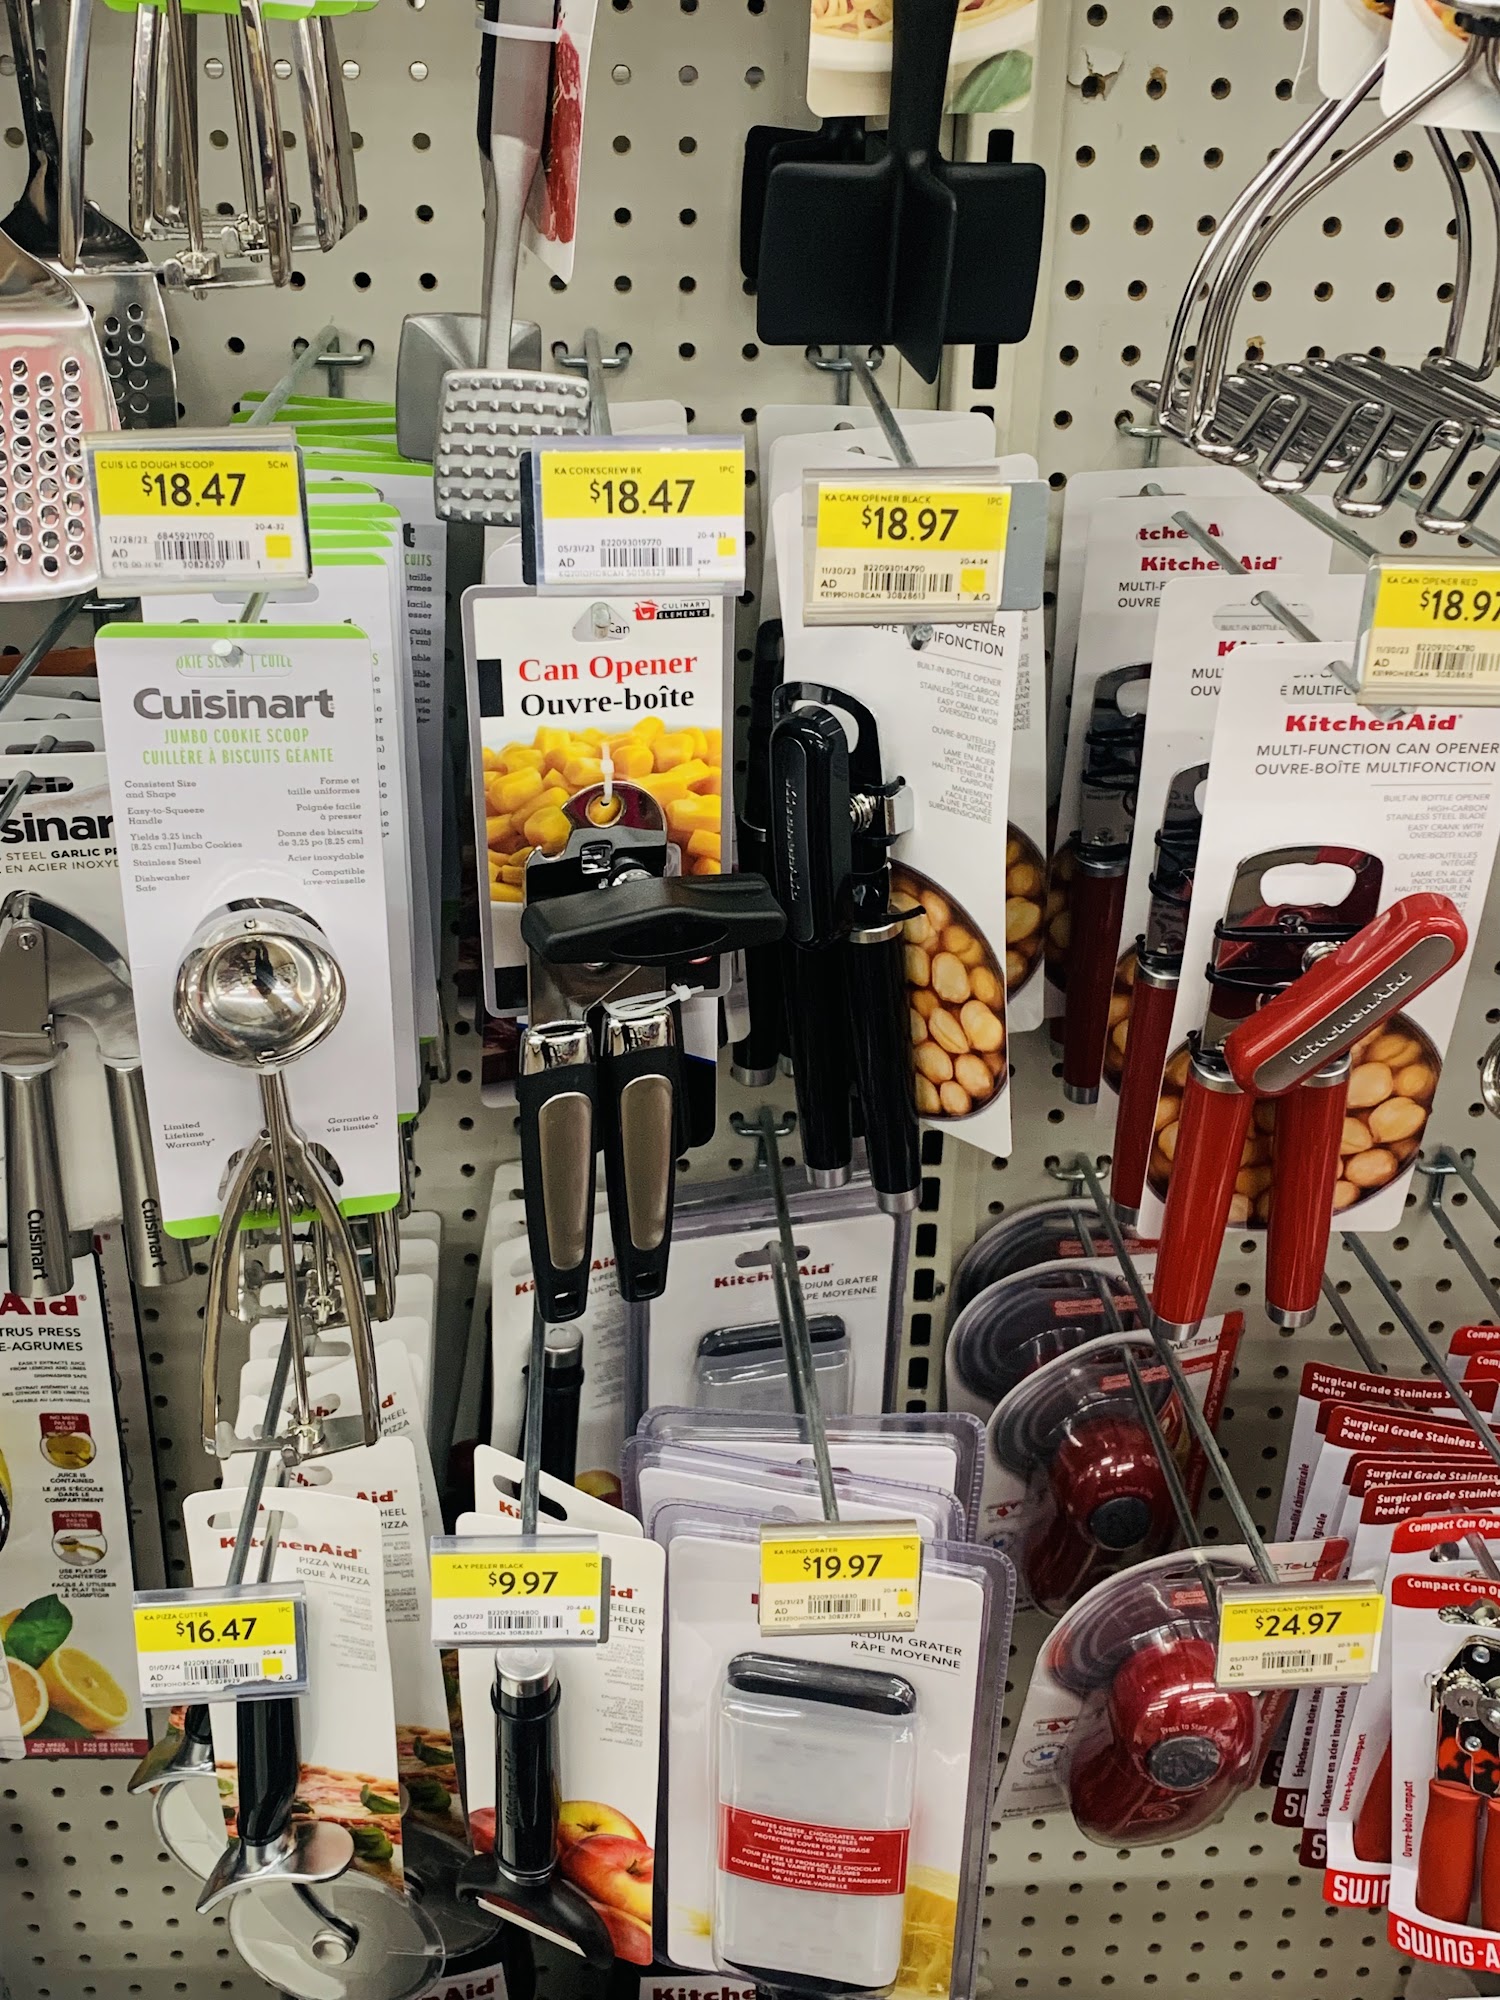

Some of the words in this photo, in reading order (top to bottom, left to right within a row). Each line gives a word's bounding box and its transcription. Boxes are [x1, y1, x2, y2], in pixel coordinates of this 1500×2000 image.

[100, 461, 124, 469] CUIS
[126, 461, 138, 469] LG
[140, 461, 177, 469] DOUGH
[180, 460, 214, 469] SCOOP
[554, 467, 567, 475] KA
[569, 467, 628, 475] CORKSCREW
[141, 472, 246, 507] $18.47
[590, 478, 695, 514] $18.47
[825, 494, 837, 502] KA
[839, 494, 860, 503] CAN
[862, 495, 900, 503] OPENER
[902, 495, 931, 504] BLACK
[861, 505, 959, 542] $18.97
[111, 549, 128, 558] AD
[558, 558, 575, 567] AD
[1140, 556, 1279, 571] KitcheAid
[821, 580, 837, 588] AD
[1422, 577, 1458, 585] OPENER
[1460, 578, 1478, 586] RED
[661, 601, 707, 610] CULINARY
[658, 610, 709, 619] ELEMENTS
[1373, 658, 1390, 666] AD
[518, 658, 579, 682] Can
[589, 655, 697, 684] Opener
[946, 667, 972, 680] BOTTLE
[973, 673, 1001, 686] OPENER
[133, 687, 335, 719] Cuisinart
[520, 684, 695, 717] Ouvre-boîte
[1285, 713, 1457, 732] KitchenAid
[164, 728, 208, 744] JUMBO
[213, 727, 262, 743] COOKIE
[267, 727, 309, 743] SCOOP
[1256, 743, 1391, 756] MULTI-FUNCTION
[1396, 742, 1431, 754] CAN
[1435, 741, 1500, 754] OPENER
[142, 748, 204, 766] CUILLÈRE
[209, 746, 217, 765] À
[222, 747, 280, 765] BISCUITS
[286, 746, 334, 764] GÉANTE
[1254, 758, 1360, 775] OUVRE-BOÎTE
[1366, 761, 1496, 774] MULTIFONCTION
[124, 779, 174, 789] Consistent
[177, 778, 197, 788] Size
[320, 776, 347, 786] Forme
[353, 776, 360, 785] et
[126, 790, 143, 799] and
[146, 790, 176, 800] Shape
[287, 787, 312, 796] taille
[314, 786, 361, 796] uniformes
[1421, 793, 1454, 803] BOTTLE
[1456, 793, 1491, 802] OPENER
[127, 806, 205, 816] Easy-to-Squeeze
[296, 802, 334, 813] Poignée
[335, 802, 361, 811] facile
[128, 817, 163, 825] Handle
[328, 813, 362, 823] presser
[130, 832, 159, 842] Yields
[161, 832, 180, 841] 3.25
[182, 831, 203, 840] inch
[277, 829, 302, 838] Donne
[305, 828, 322, 838] des
[324, 827, 363, 837] biscuits
[173, 841, 203, 852] Jumbo
[205, 841, 243, 850] Cookies
[6, 851, 47, 862] STEEL
[51, 848, 100, 860] GARLIC
[287, 853, 312, 863] Acier
[313, 852, 364, 864] inoxydable
[5, 865, 23, 875] EN
[28, 862, 67, 873] ACIER
[133, 857, 177, 868] Stainless
[179, 857, 202, 866] Steel
[134, 873, 191, 883] Dishwasher
[312, 867, 365, 879] Compatible
[303, 877, 366, 887] lave-vaisselle
[135, 884, 157, 893] Safe
[163, 1121, 201, 1131] Limited
[327, 1115, 371, 1125] Garantie
[164, 1131, 205, 1140] Lifetime
[141, 1197, 168, 1268] Cuisinart
[27, 1209, 49, 1281] Cuisinart
[836, 1275, 878, 1287] GRATER
[822, 1286, 877, 1299] MOYENNE
[38, 1327, 81, 1337] PRESS
[1311, 1382, 1346, 1398] Peeler
[1313, 1372, 1357, 1390] Surgical
[1359, 1383, 1391, 1396] Grade
[1393, 1385, 1442, 1399] Stainless
[1340, 1428, 1377, 1444] Peeler
[1342, 1416, 1389, 1434] Surgical
[1390, 1425, 1423, 1441] Grade
[1425, 1431, 1476, 1449] Stainless
[1374, 1504, 1411, 1516] Peeler
[1408, 1520, 1454, 1534] Compact
[1456, 1518, 1476, 1529] Can
[299, 1555, 330, 1568] PIZZA
[332, 1562, 371, 1575] WHEEL
[803, 1554, 883, 1579] $19.97
[296, 1566, 326, 1579] ROUE
[340, 1574, 370, 1587] PIZZA
[488, 1571, 559, 1595] $9.97
[1407, 1578, 1461, 1592] Compact
[1463, 1583, 1486, 1595] Can
[144, 1614, 155, 1622] KA
[156, 1613, 177, 1621] PIZZA
[179, 1611, 208, 1620] CUTTER
[618, 1625, 634, 1633] EN
[1255, 1611, 1343, 1637] $24.97
[176, 1617, 257, 1644] $16.47
[908, 1638, 963, 1657] GRATER
[850, 1639, 886, 1654] RÂPE
[891, 1648, 961, 1670] MOYENNE
[150, 1674, 164, 1682] AD
[1403, 1780, 1416, 1812] compact
[751, 1818, 778, 1831] GRATES
[796, 1839, 821, 1849] COVER
